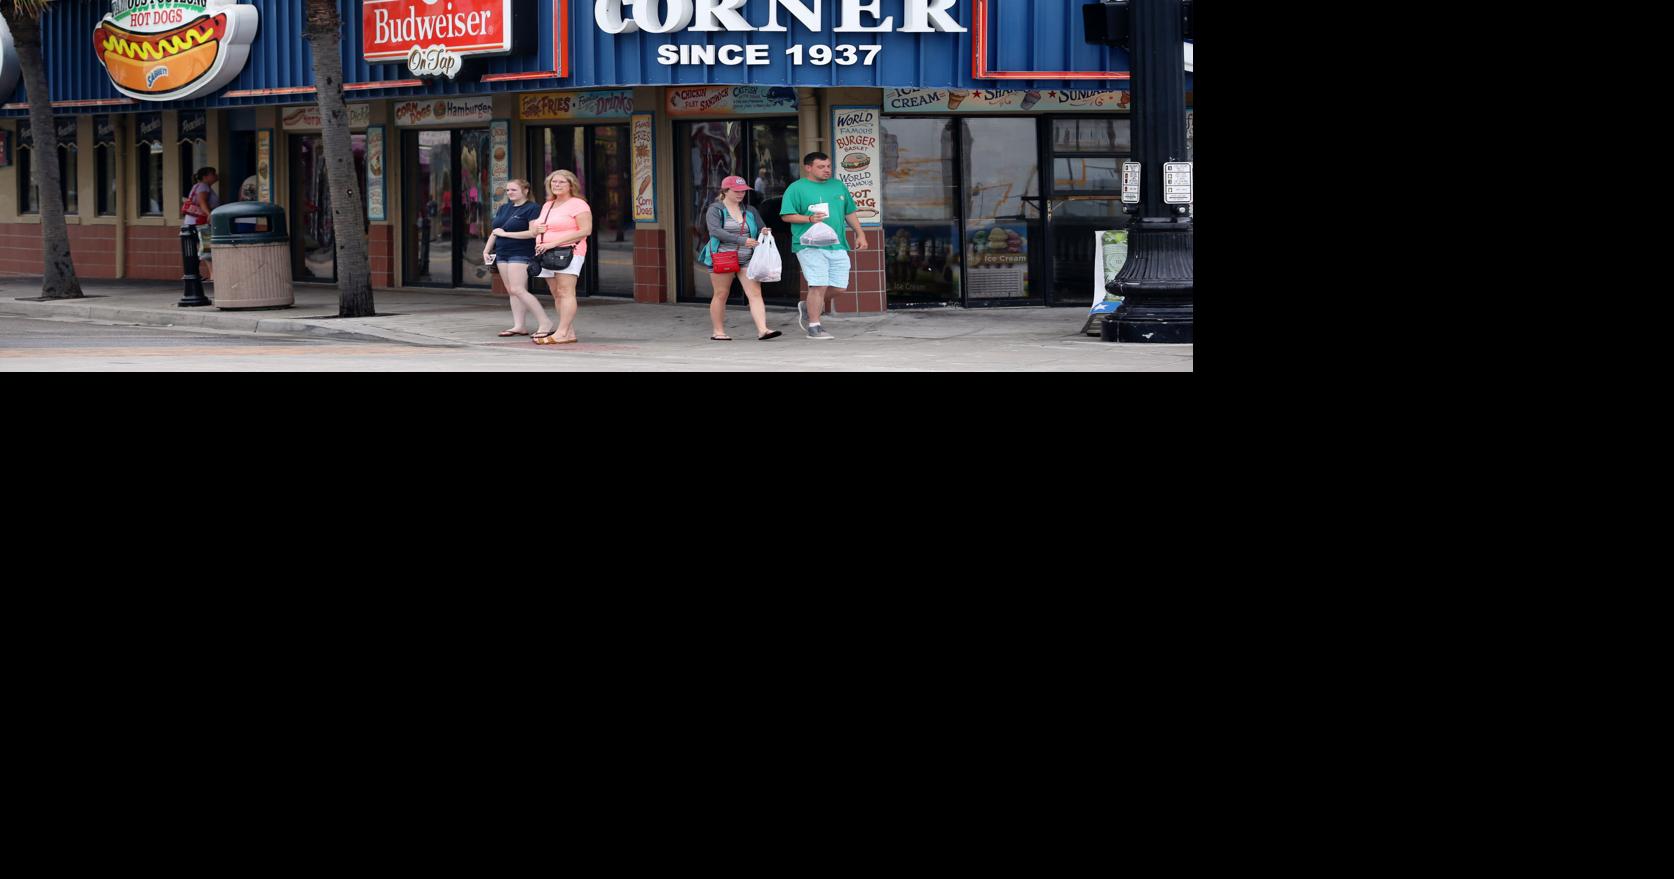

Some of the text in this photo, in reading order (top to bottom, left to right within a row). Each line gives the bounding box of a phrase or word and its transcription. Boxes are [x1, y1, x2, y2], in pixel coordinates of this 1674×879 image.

[130, 8, 183, 27] HOT DOGS
[374, 3, 491, 44] Budweiser
[408, 47, 455, 74] On Tap
[657, 44, 882, 66] SINCE 1937
[540, 95, 571, 117] FRIES
[890, 91, 940, 109] CREAM
[396, 101, 418, 120] CORN
[409, 104, 431, 125] DOGS
[837, 112, 873, 127] WORLD
[840, 127, 873, 135] FAMOUS
[836, 135, 876, 149] BURGER
[839, 171, 871, 183] WORLD
[846, 179, 873, 189] FAMOUS
[849, 189, 871, 198] OOT
